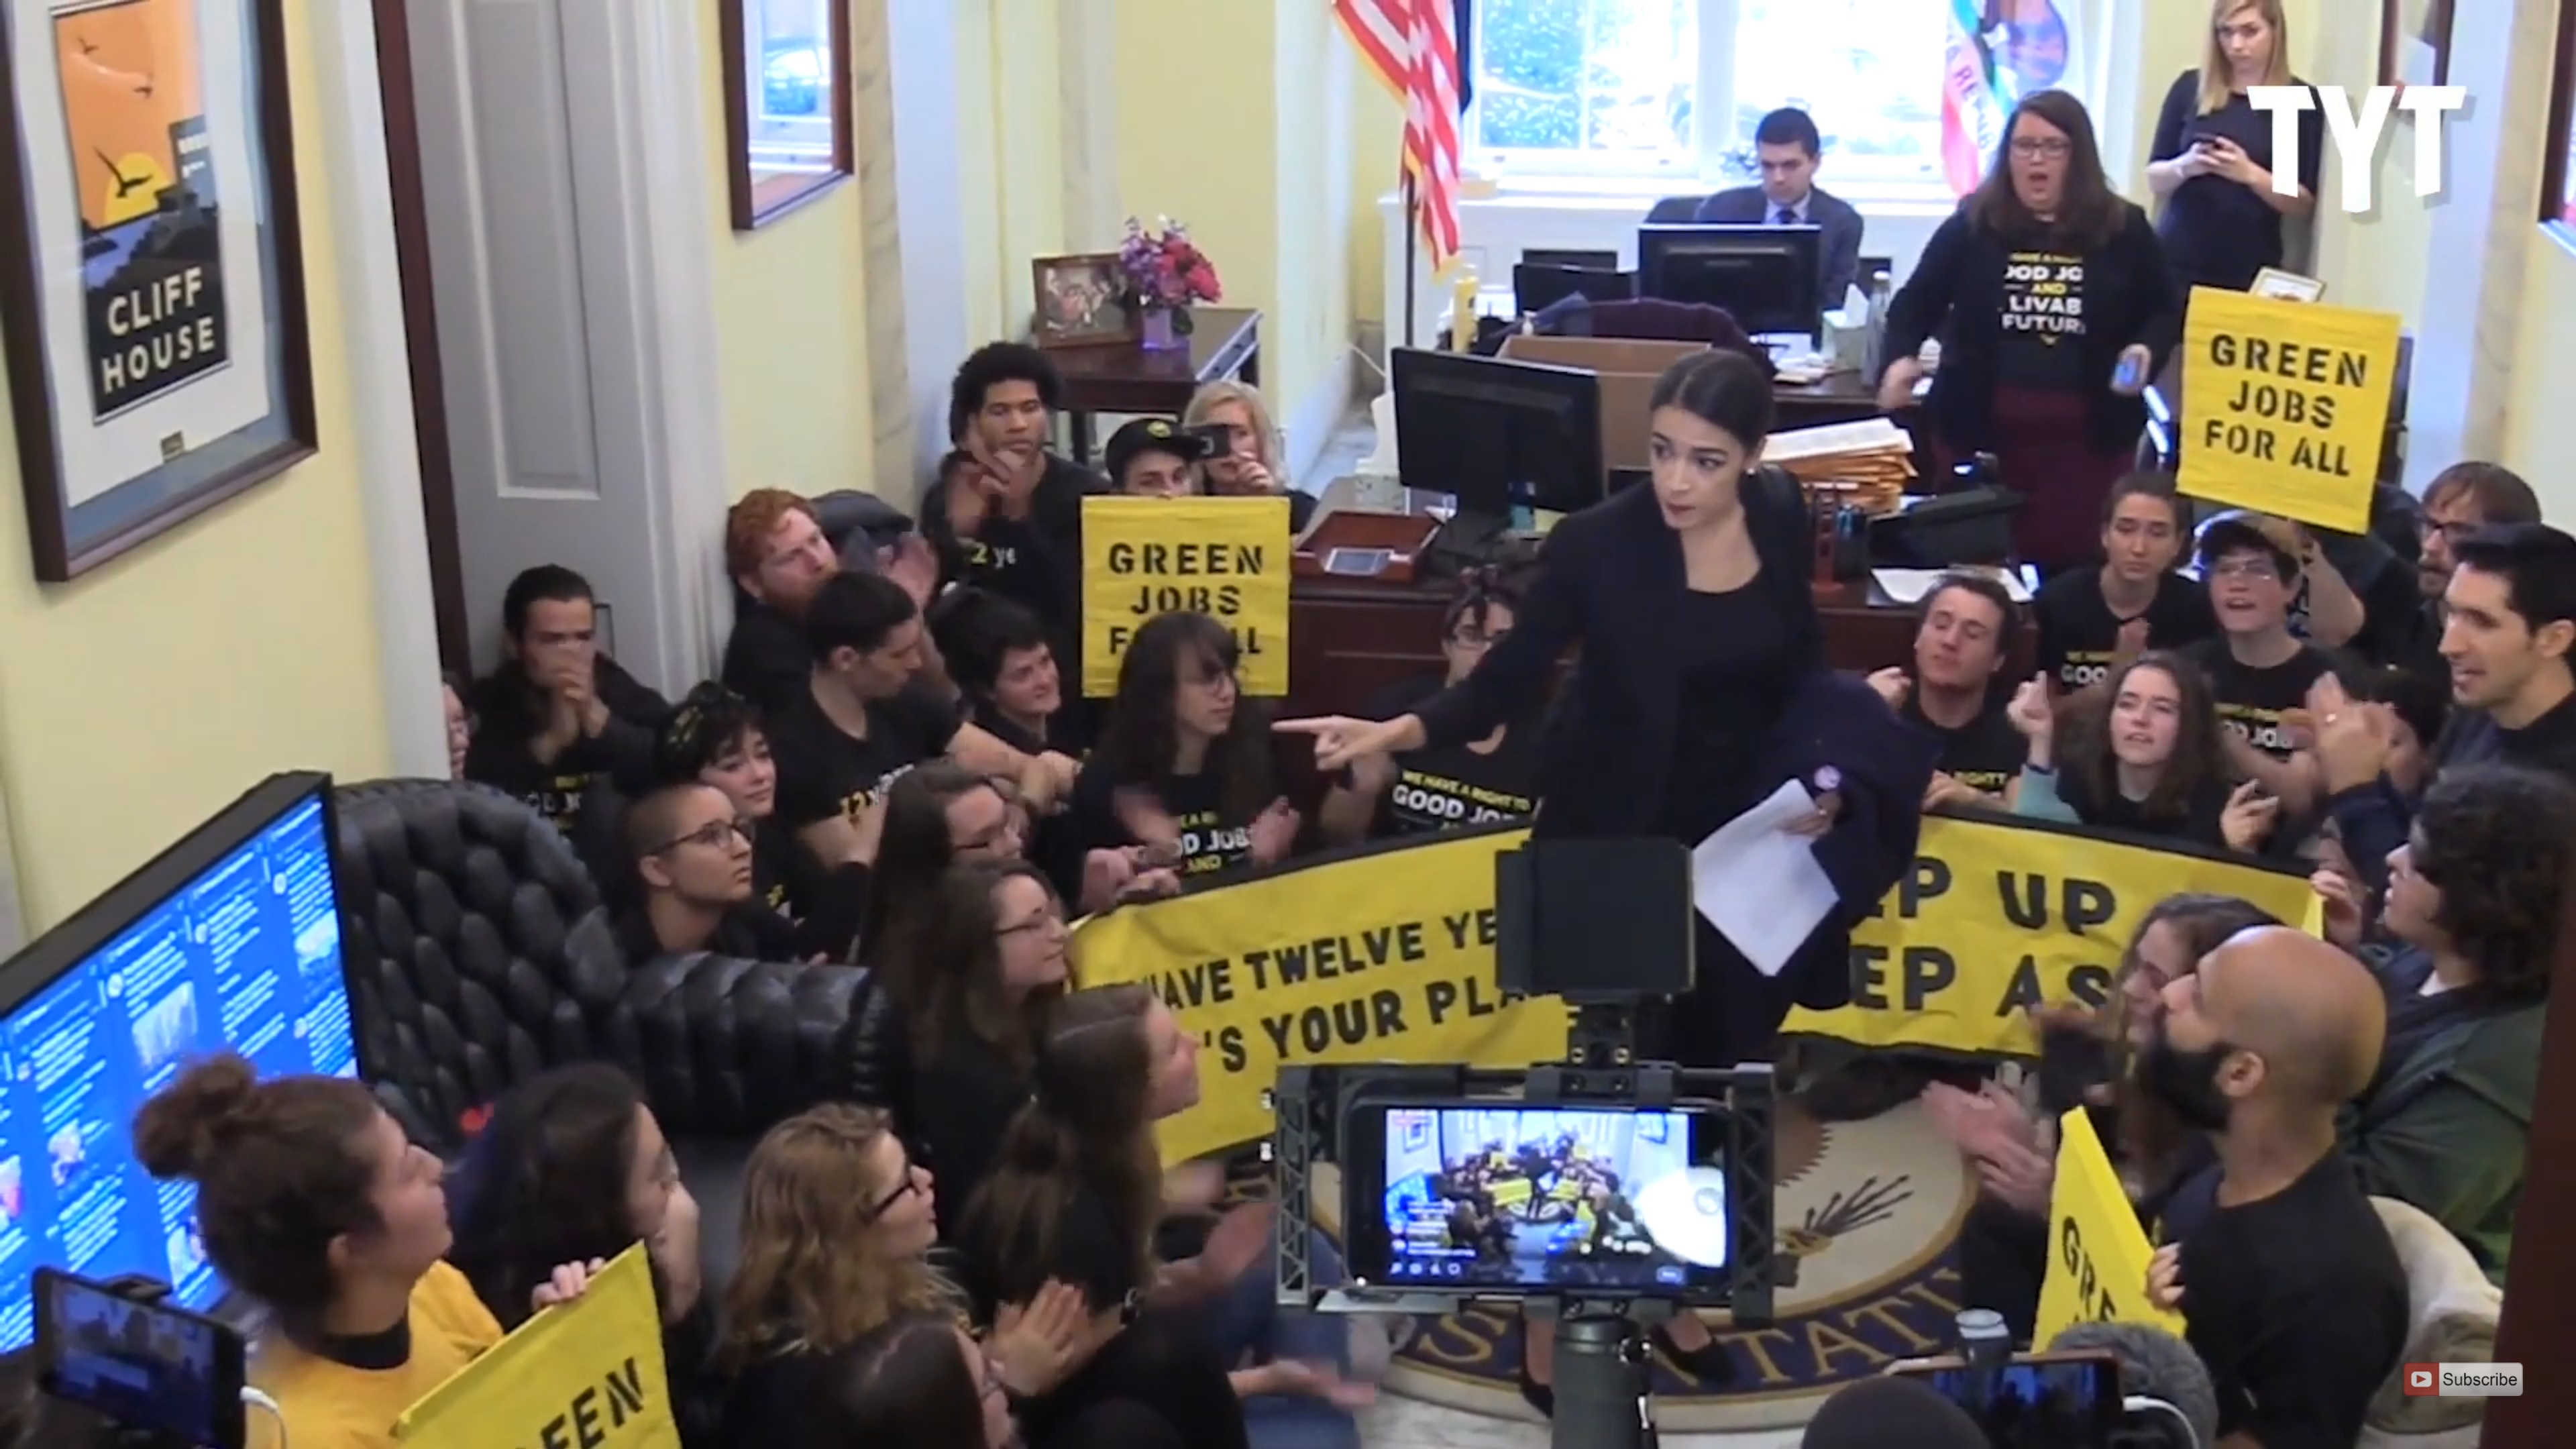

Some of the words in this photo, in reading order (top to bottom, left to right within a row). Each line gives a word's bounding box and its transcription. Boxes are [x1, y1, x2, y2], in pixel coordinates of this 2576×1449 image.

[107, 266, 203, 335] CLIFF
[2031, 282, 2067, 295] AND
[102, 316, 215, 394] HOUSE
[2210, 333, 2367, 388] GREEN
[2228, 380, 2336, 429] JOBS
[2205, 419, 2275, 462] FOR
[2290, 437, 2351, 477] ALL
[1109, 542, 1263, 575] GREEN
[1130, 586, 1240, 615] JOBS
[1393, 783, 1465, 819] GOOD
[1996, 869, 2118, 936] UP
[1243, 922, 1426, 991] TWELVE
[1260, 989, 1408, 1060] YOUR
